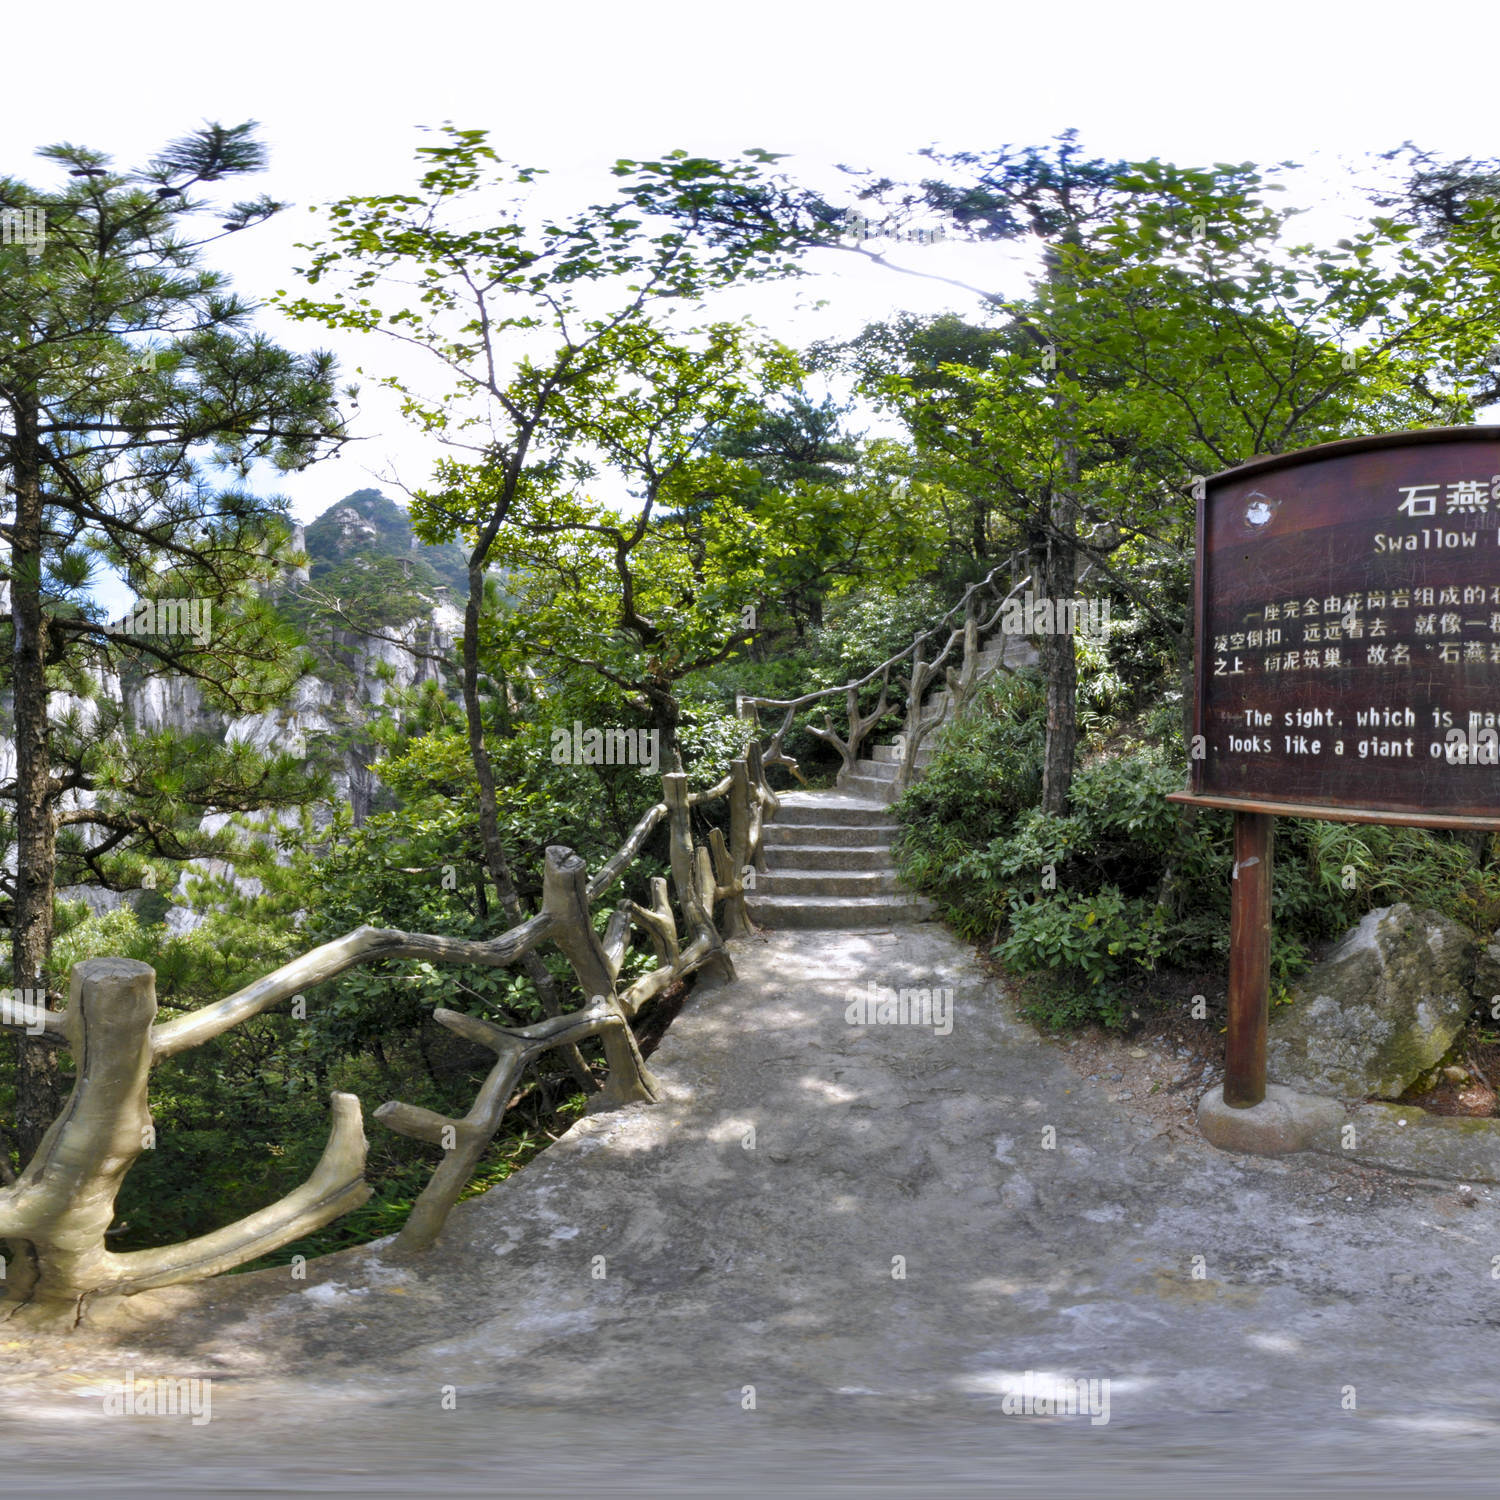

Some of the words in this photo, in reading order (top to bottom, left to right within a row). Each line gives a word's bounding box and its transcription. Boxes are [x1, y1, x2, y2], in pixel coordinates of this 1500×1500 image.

[1373, 527, 1477, 554] Swallow
[1245, 709, 1273, 727] The
[1356, 706, 1416, 728] which
[1431, 707, 1453, 728] is
[1228, 734, 1272, 753] looks
[1284, 735, 1322, 755] like
[1334, 740, 1344, 755] a
[1358, 736, 1415, 759] giant
